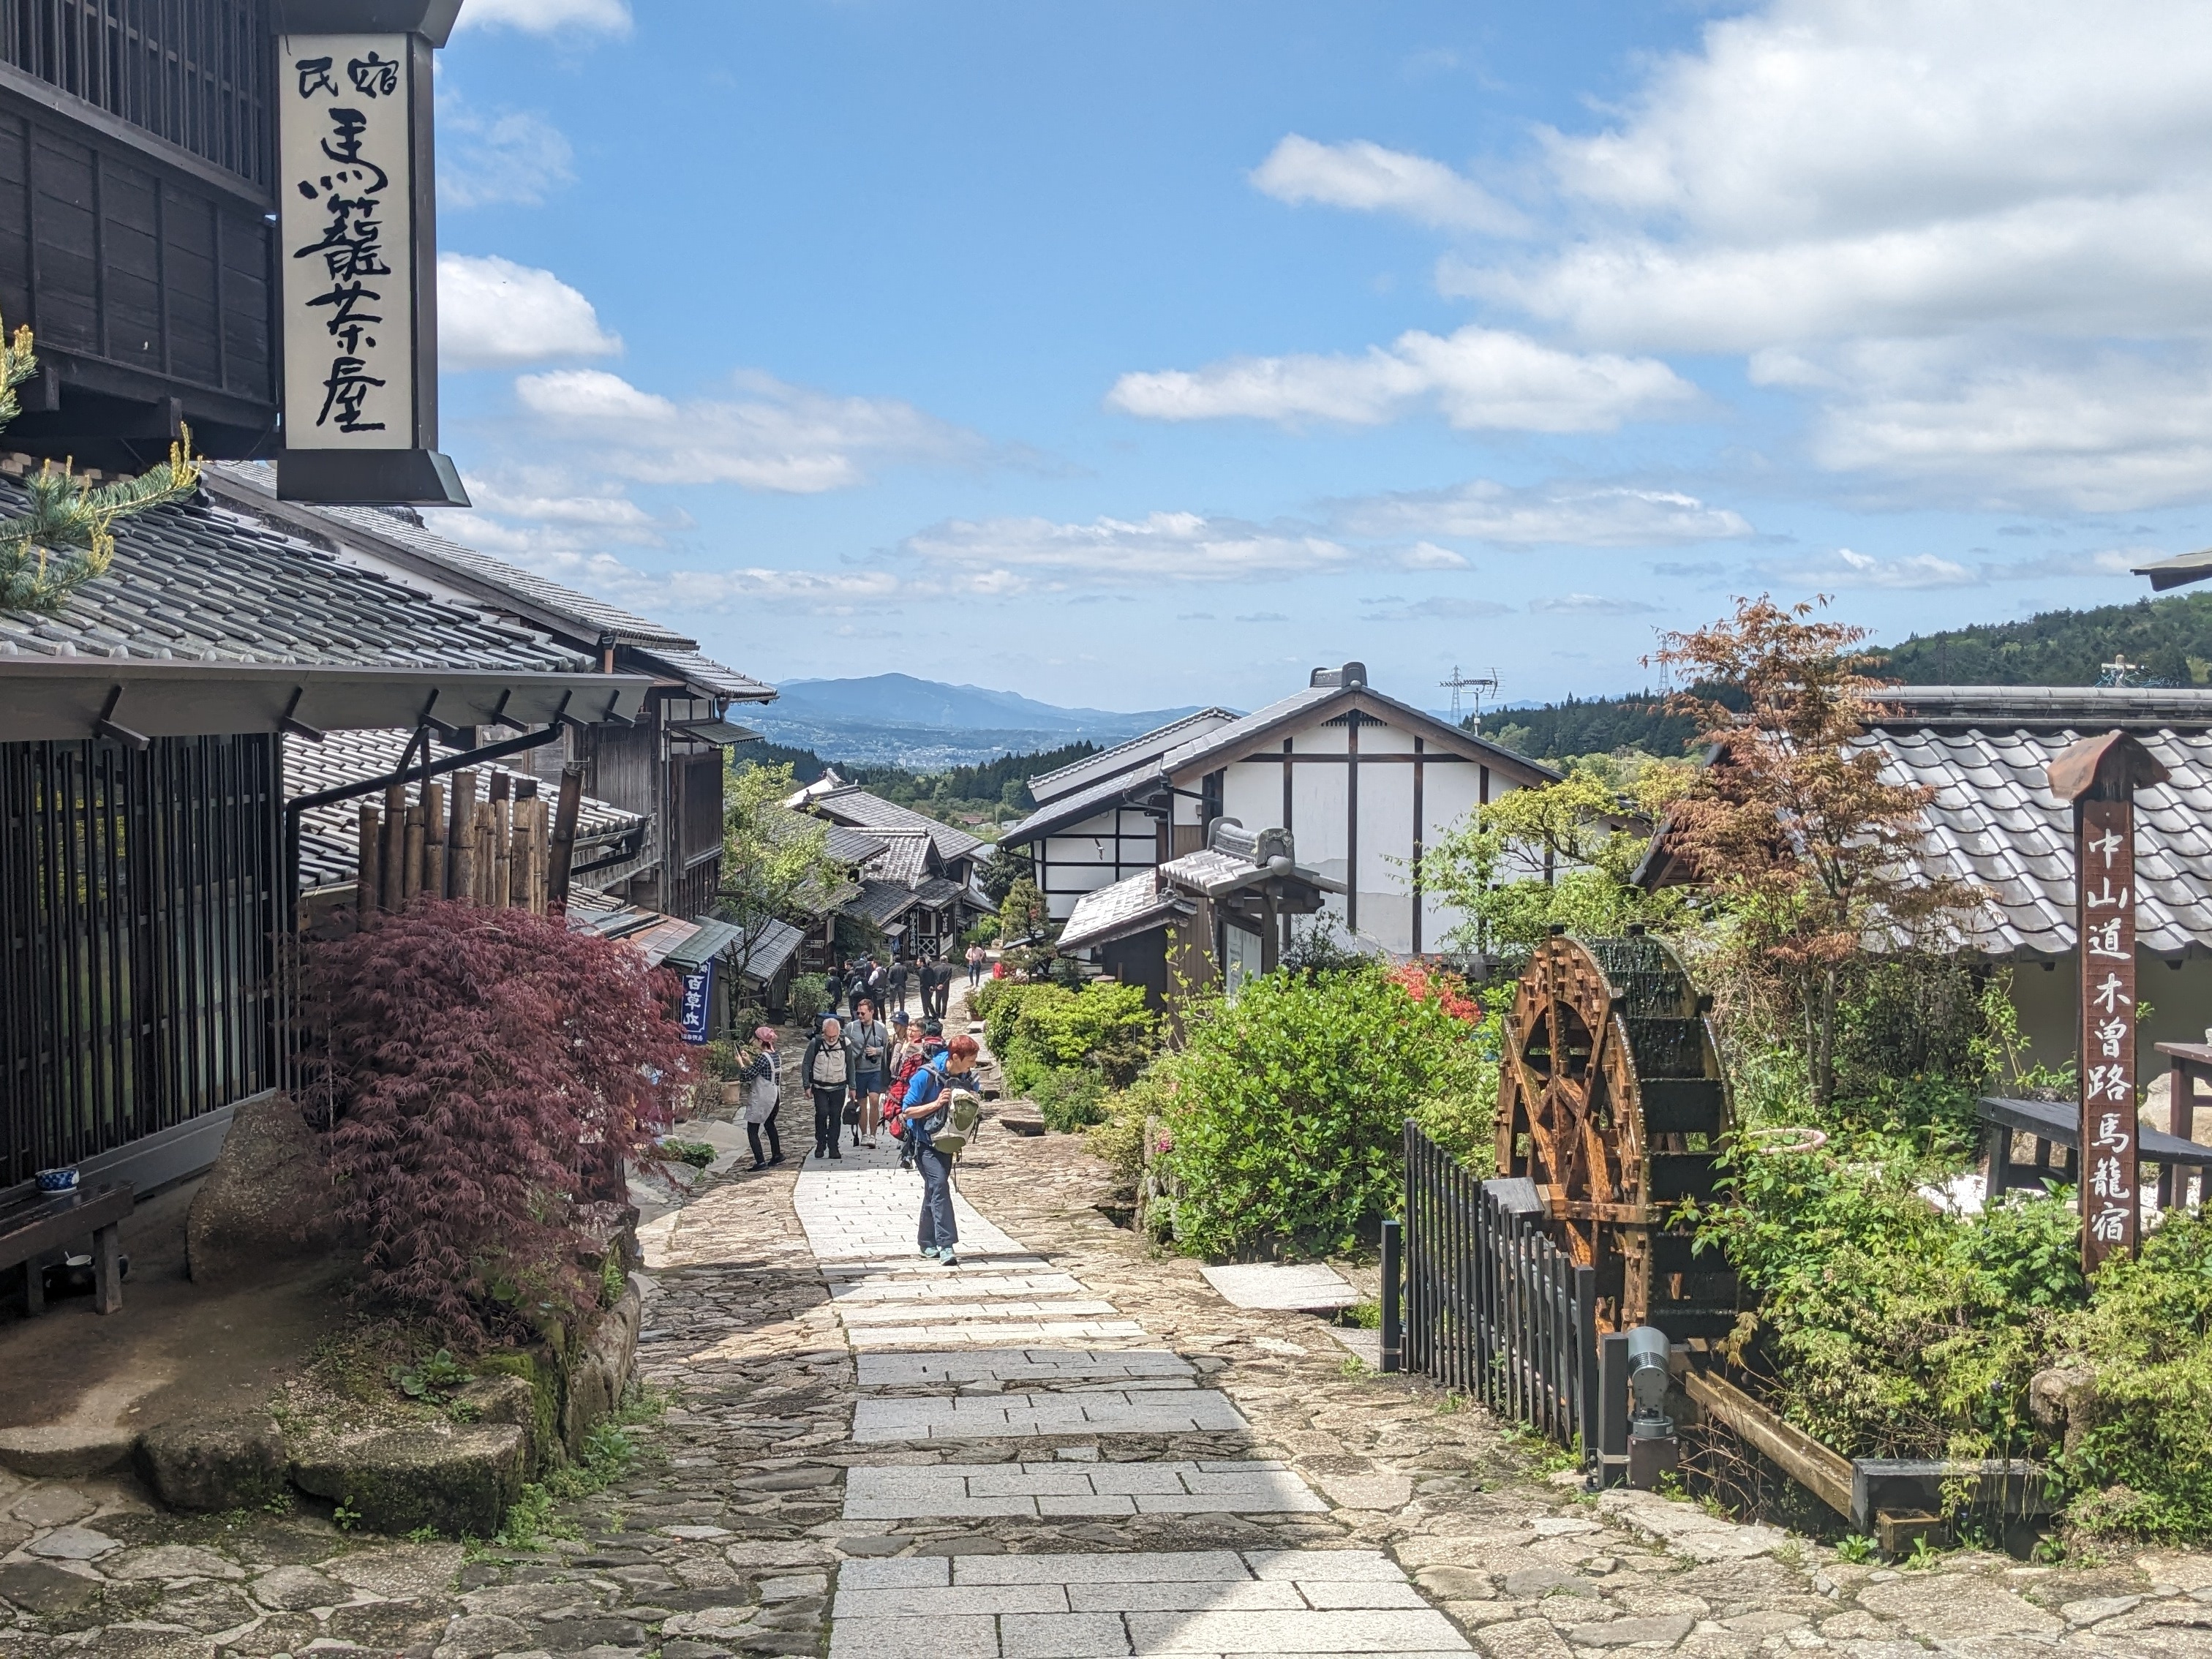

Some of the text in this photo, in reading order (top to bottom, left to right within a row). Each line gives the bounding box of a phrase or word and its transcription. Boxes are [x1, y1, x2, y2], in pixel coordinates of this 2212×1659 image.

[295, 50, 399, 99] 民宿
[293, 107, 391, 434] 馬籠茶屋
